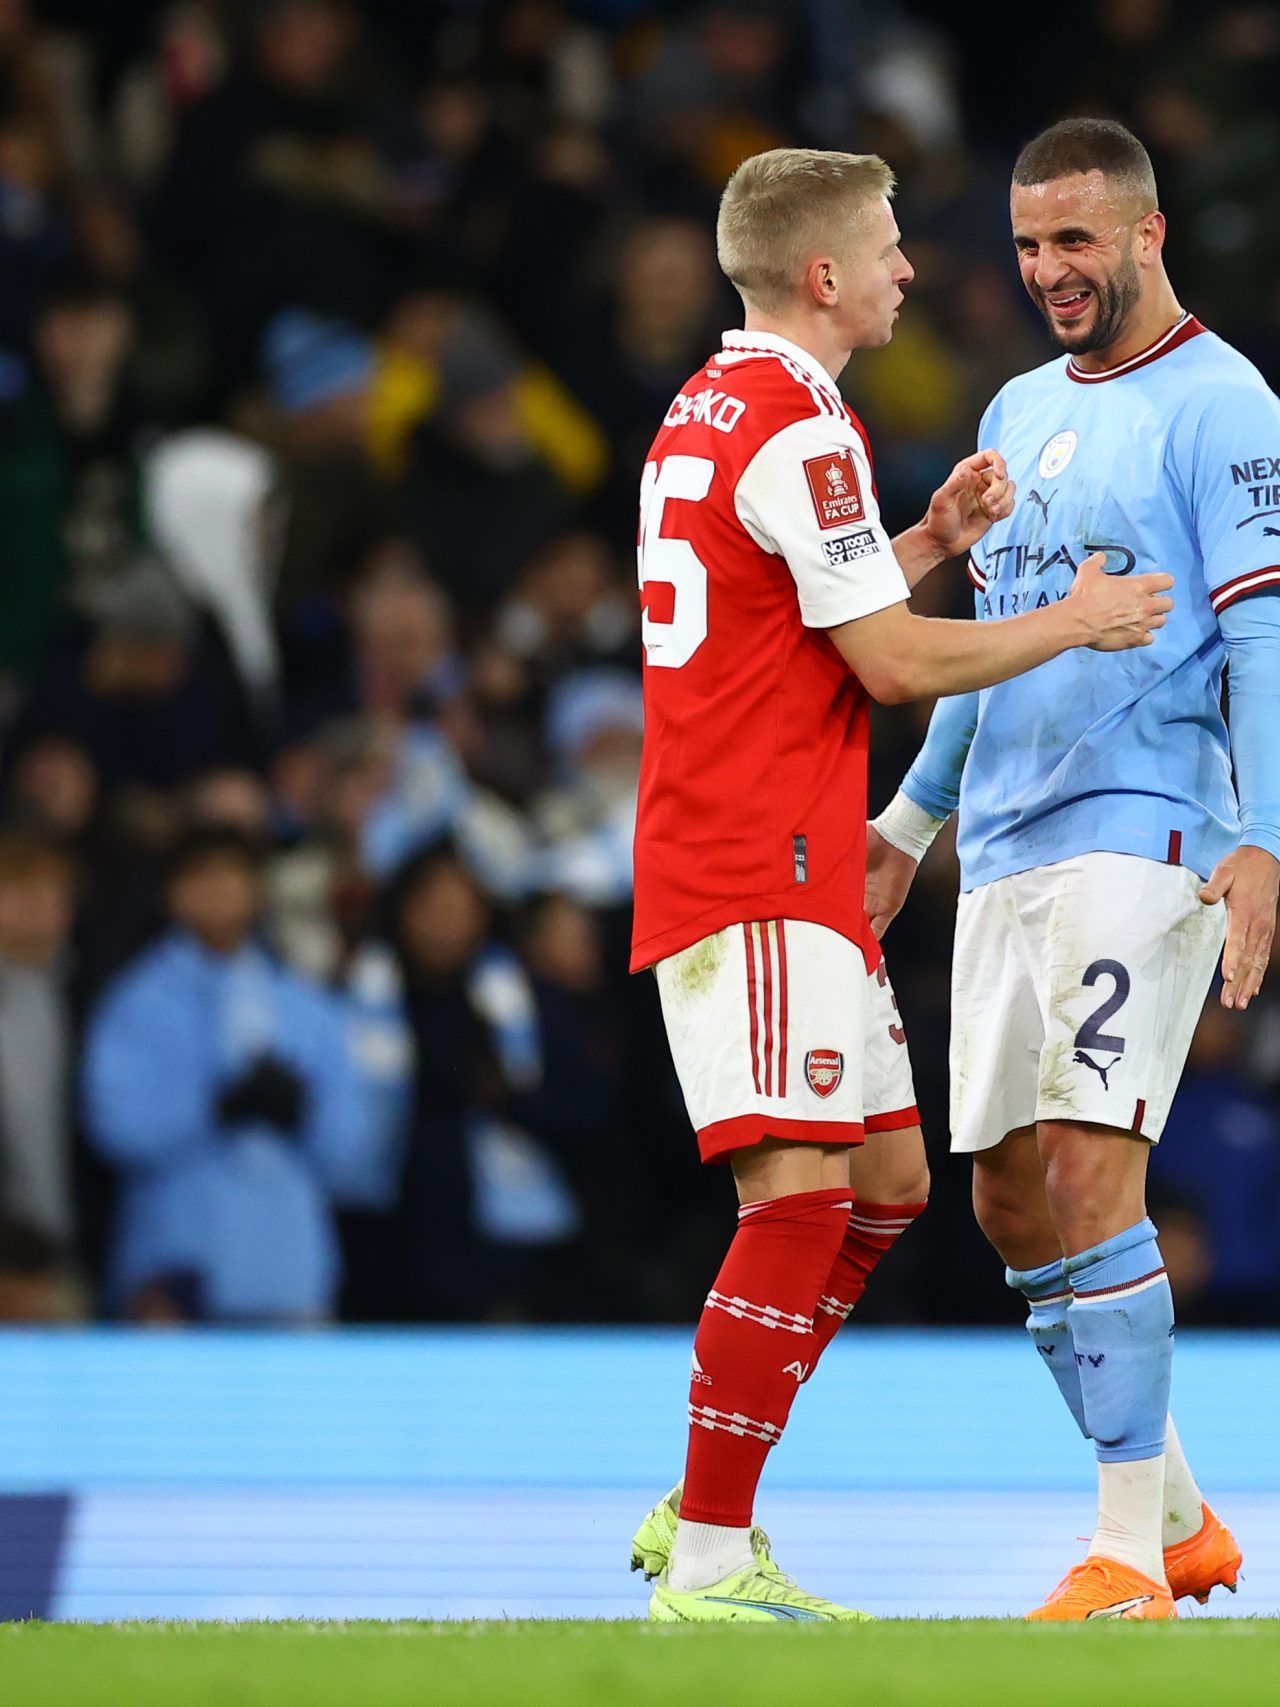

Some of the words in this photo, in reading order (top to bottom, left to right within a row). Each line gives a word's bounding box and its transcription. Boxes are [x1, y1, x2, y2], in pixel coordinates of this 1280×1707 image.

[822, 495, 858, 510] Emirates
[825, 508, 840, 520] FA
[840, 503, 859, 516] CUP
[821, 541, 844, 556] No
[843, 533, 873, 550] room
[826, 552, 845, 567] for
[846, 543, 881, 560] racism
[1073, 958, 1131, 1054] 2
